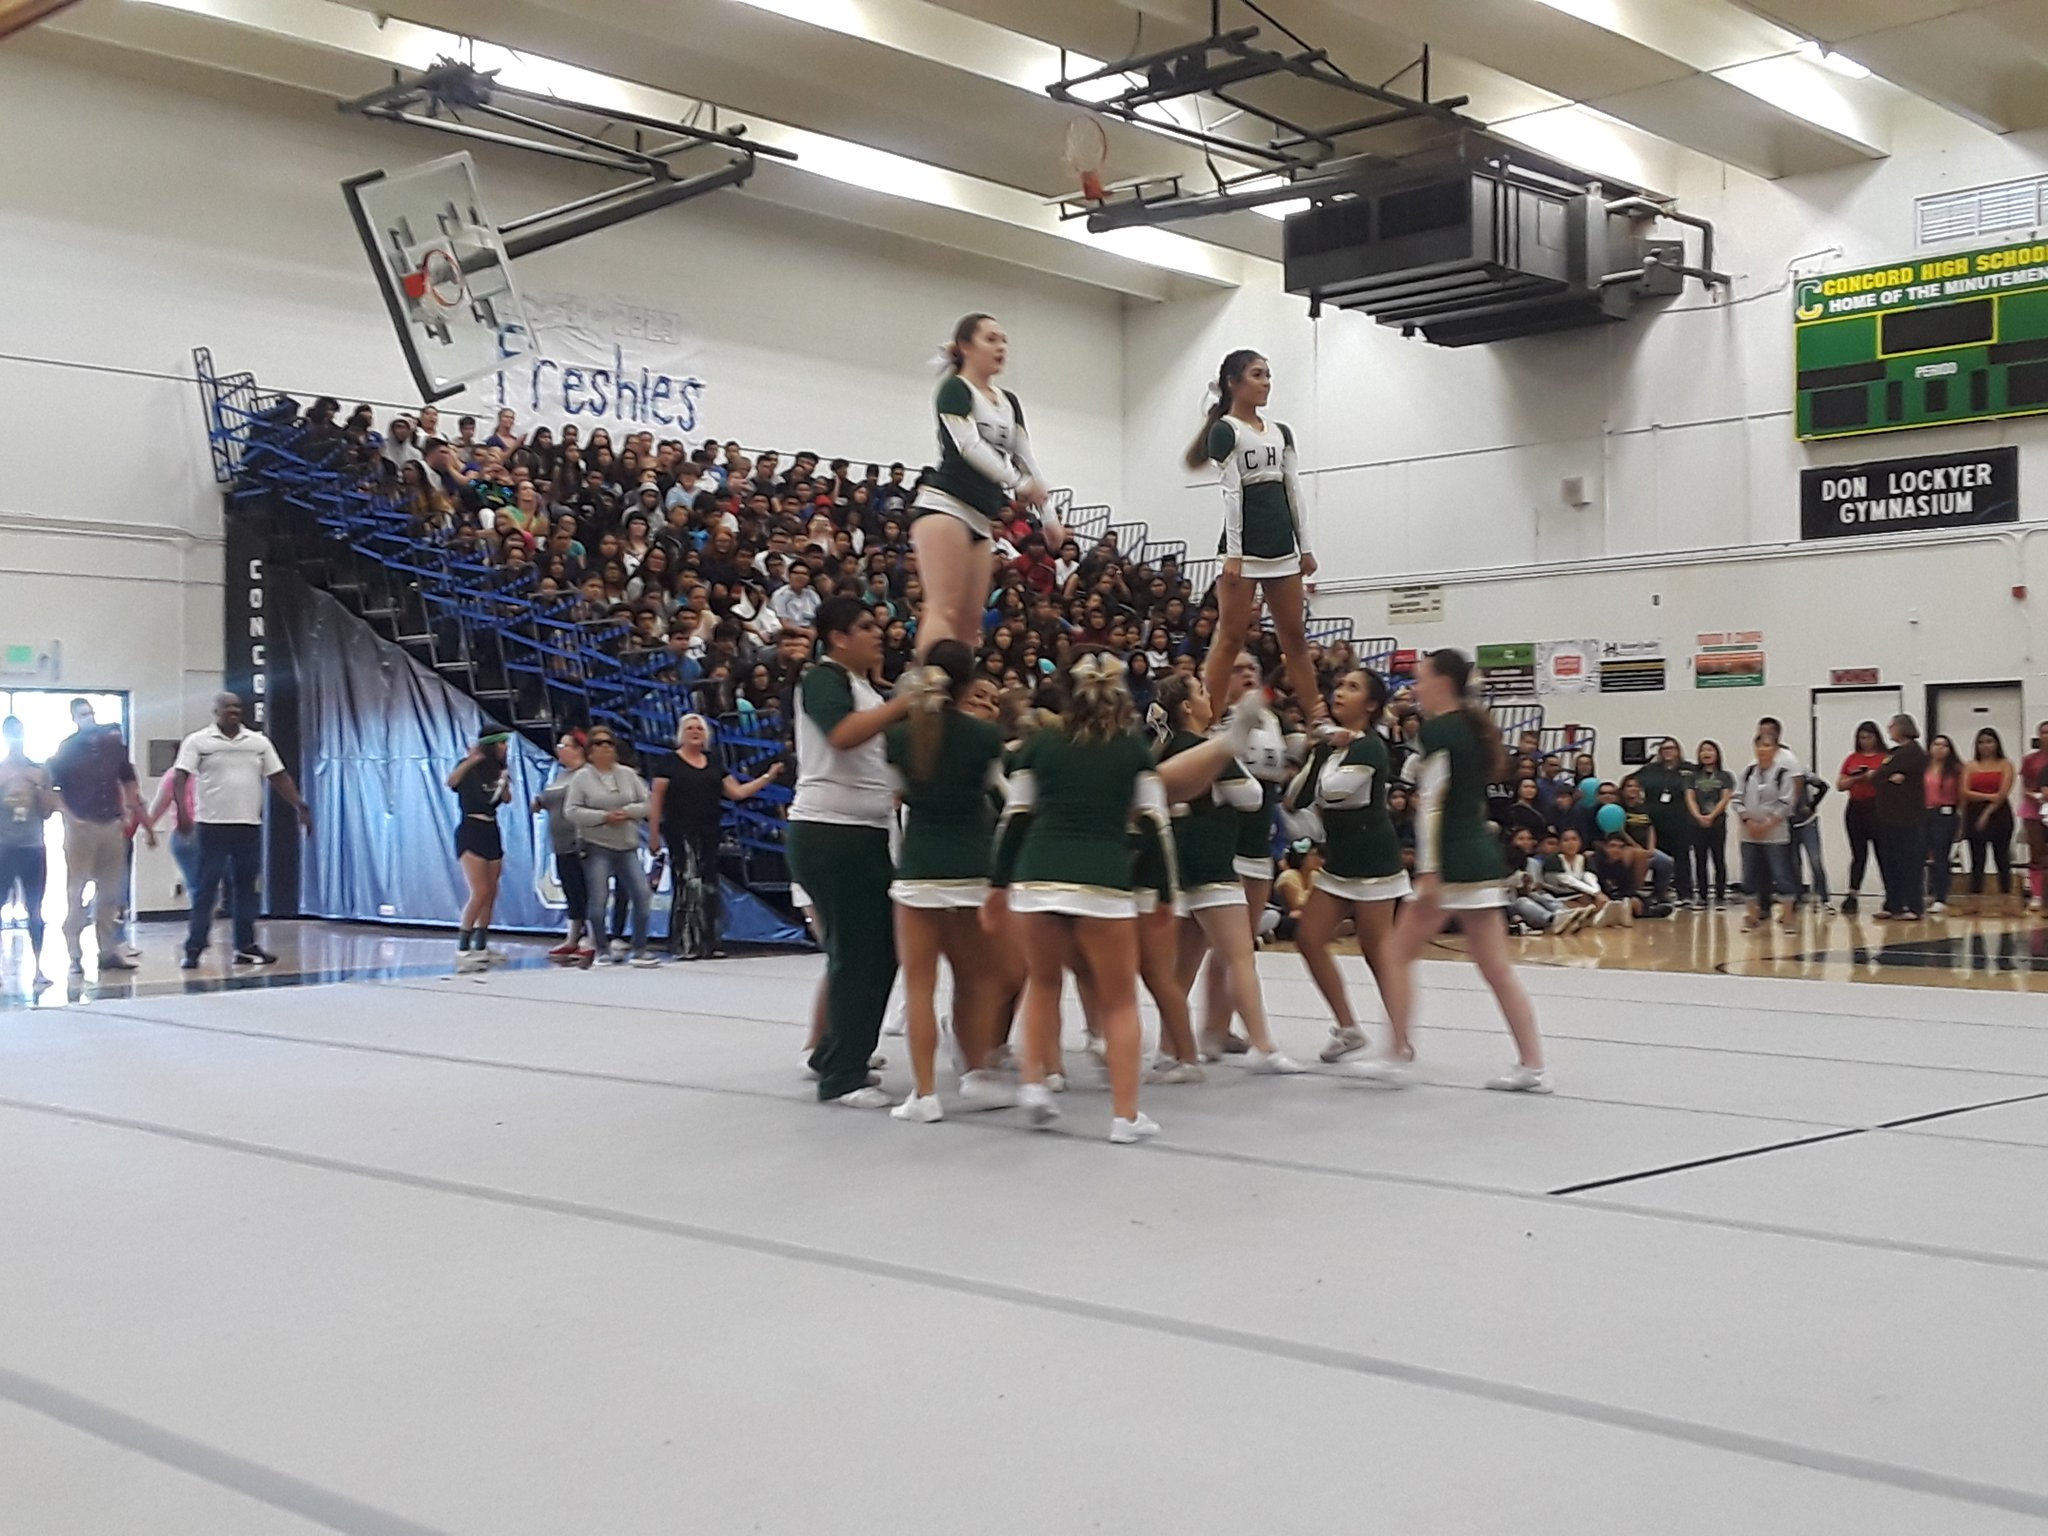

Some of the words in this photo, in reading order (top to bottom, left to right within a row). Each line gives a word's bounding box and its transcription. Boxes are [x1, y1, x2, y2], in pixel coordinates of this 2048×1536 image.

[1823, 267, 1914, 297] CONCORD
[1920, 257, 1970, 281] HIGH
[1976, 245, 2048, 272] SCHOO
[1828, 294, 1877, 313] HOME
[1879, 288, 1903, 305] OF
[1907, 283, 1941, 301] THE
[1821, 476, 1868, 501] DON
[1888, 462, 1992, 495] LOCKYER
[1839, 490, 1974, 524] GYMNASIUM
